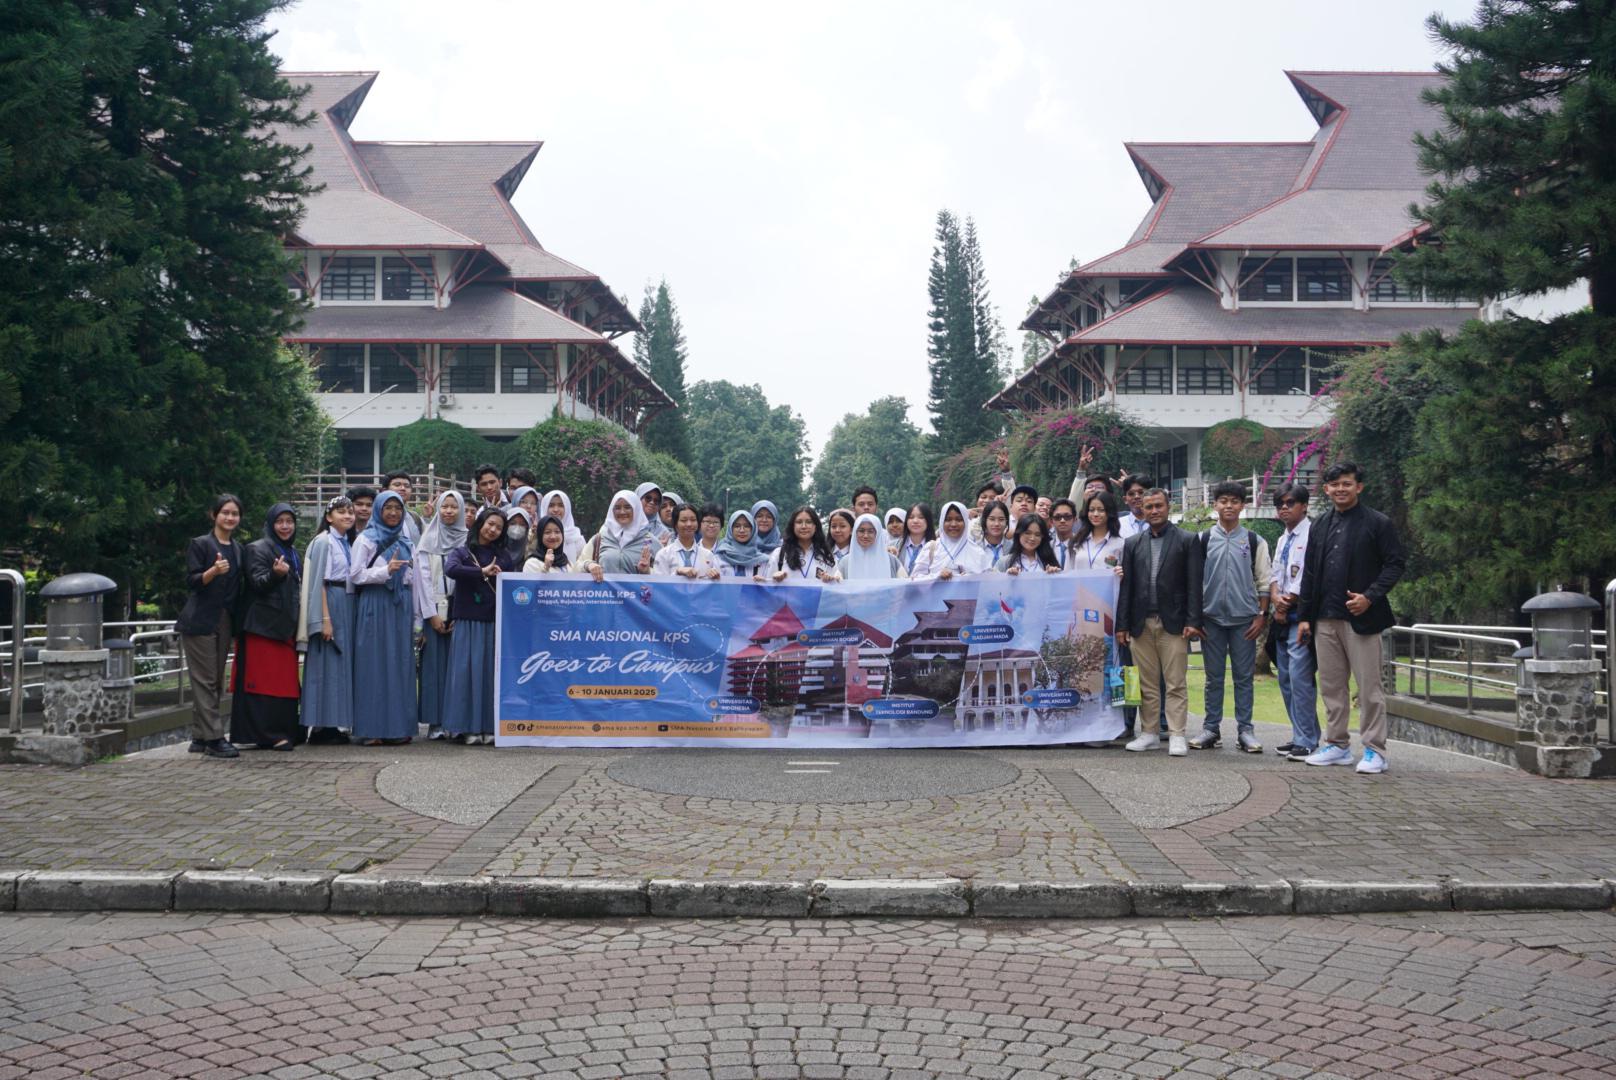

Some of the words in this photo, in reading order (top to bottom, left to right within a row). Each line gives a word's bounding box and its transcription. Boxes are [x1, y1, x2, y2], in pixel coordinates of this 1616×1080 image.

[537, 590, 560, 598] SMA
[562, 590, 615, 599] NASIONAL
[616, 591, 637, 599] KPS
[550, 630, 582, 642] SMA
[585, 631, 660, 643] NASIONAL
[663, 632, 690, 644] KPS
[517, 651, 585, 685] Goes
[587, 653, 618, 674] to
[619, 650, 720, 683] Campus
